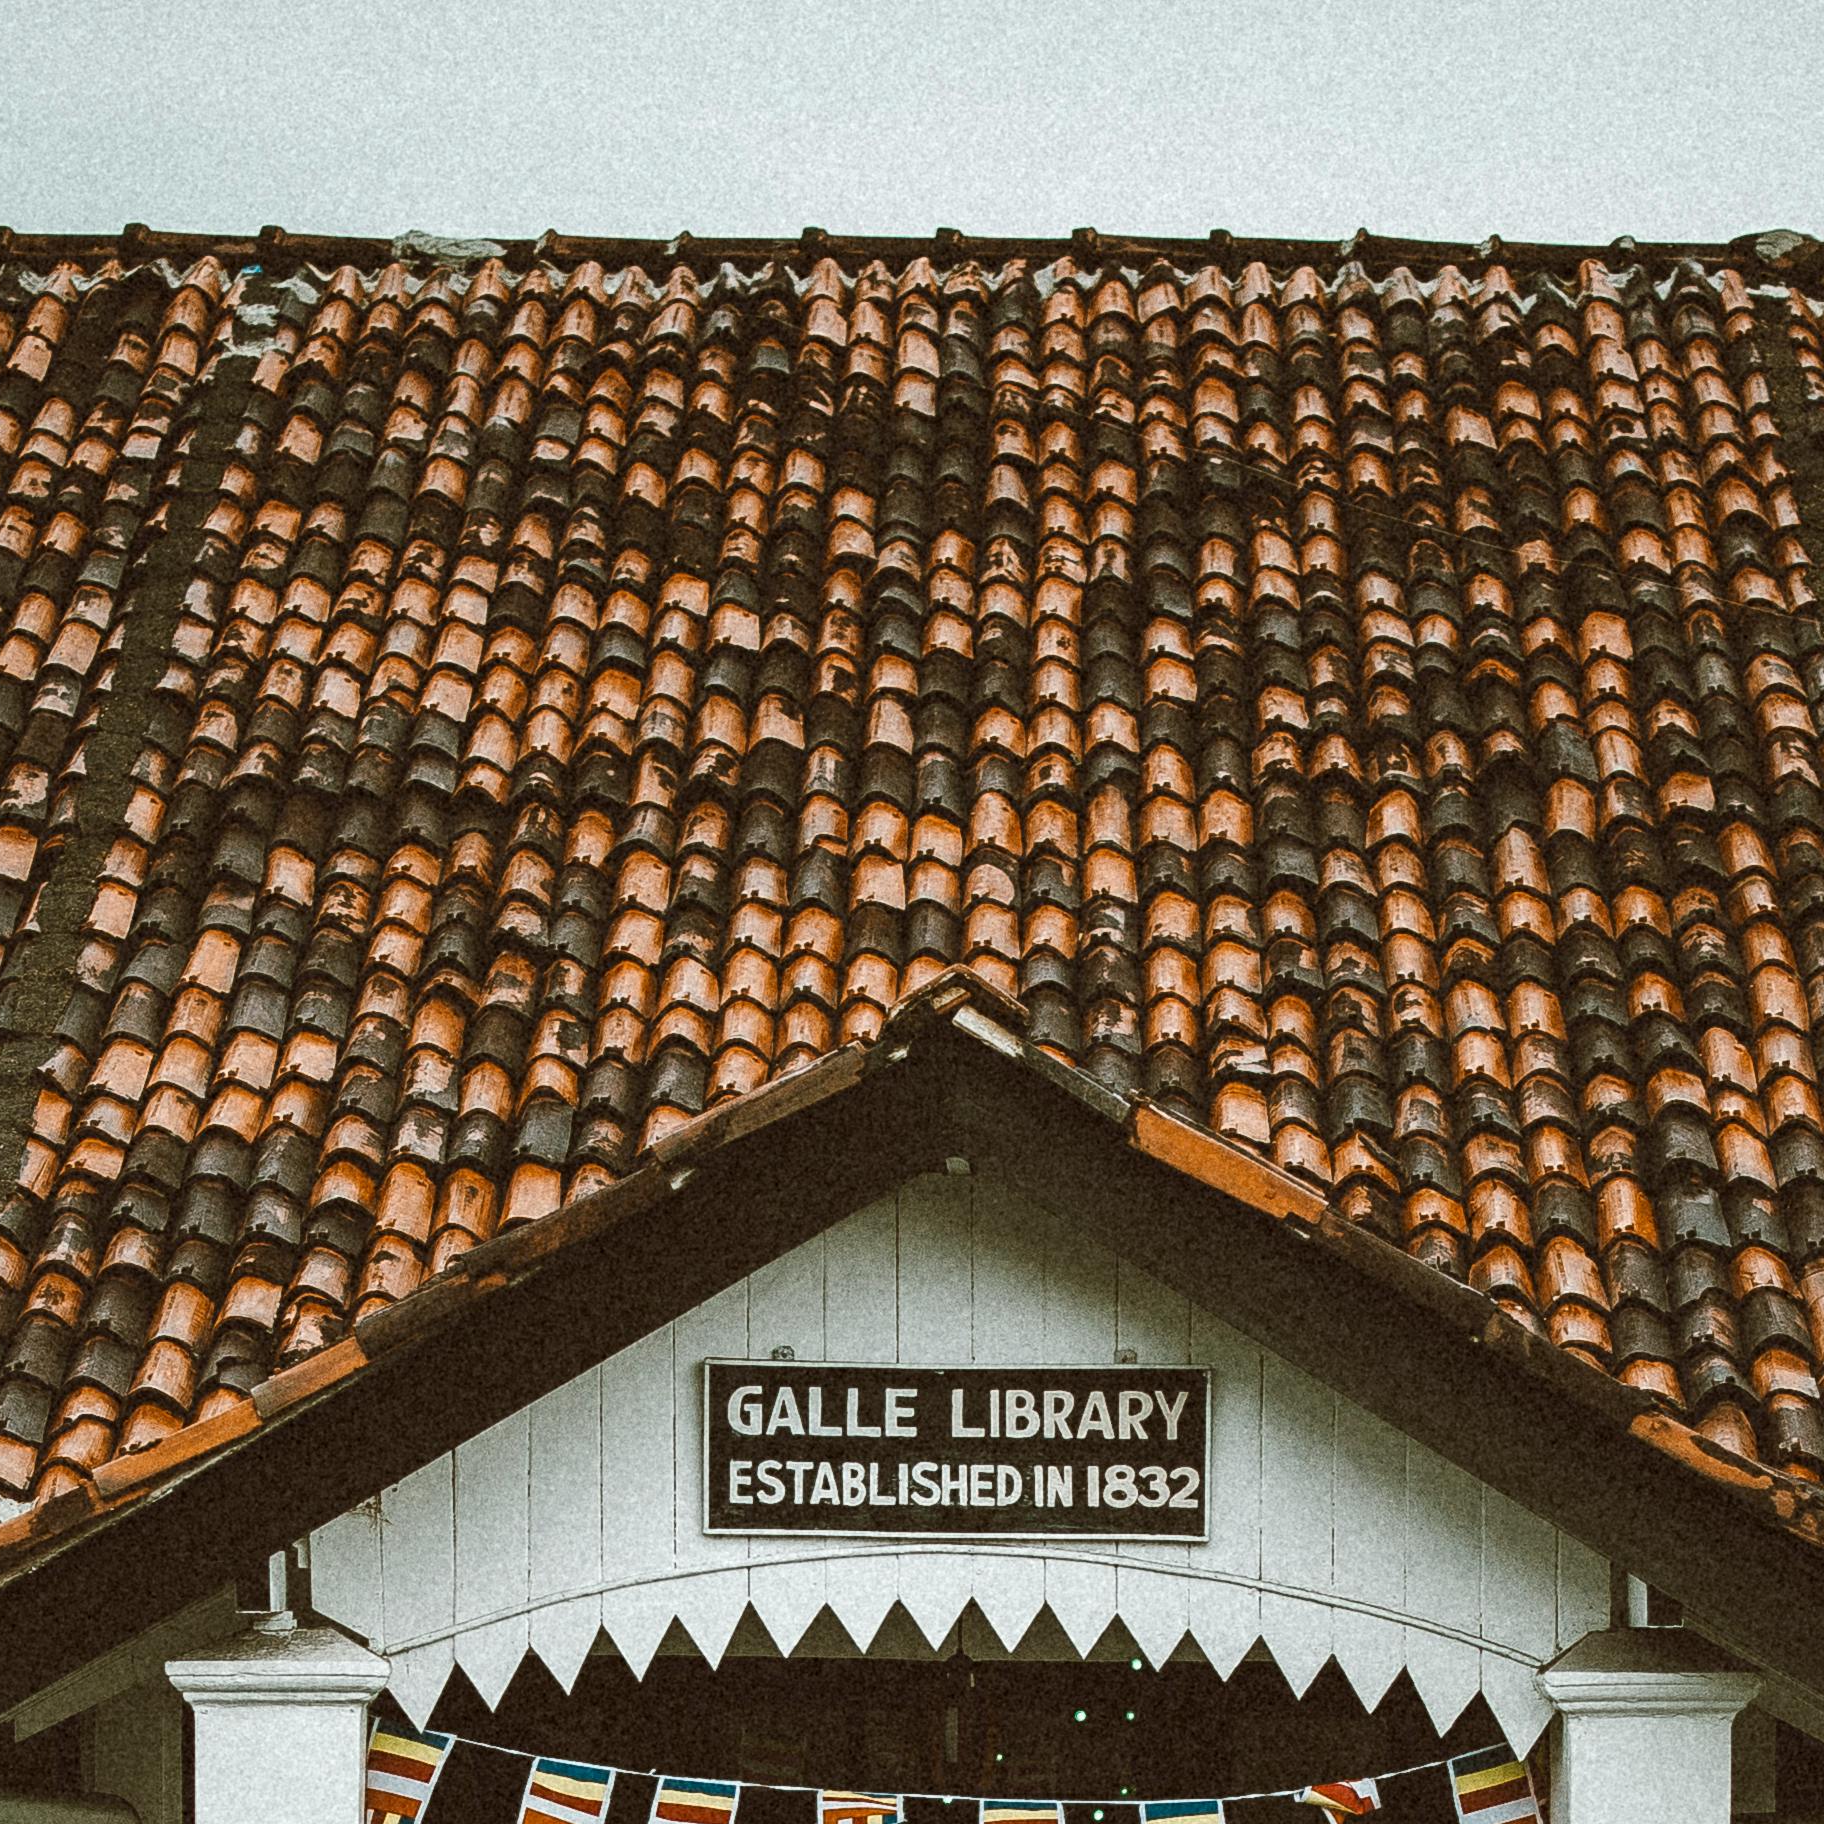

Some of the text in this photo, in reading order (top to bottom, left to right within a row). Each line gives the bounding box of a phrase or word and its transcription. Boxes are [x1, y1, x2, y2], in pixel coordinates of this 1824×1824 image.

[727, 1385, 1188, 1440] GALLE LIBRARY
[729, 1460, 1200, 1509] ESTABLISHED IN 1832
